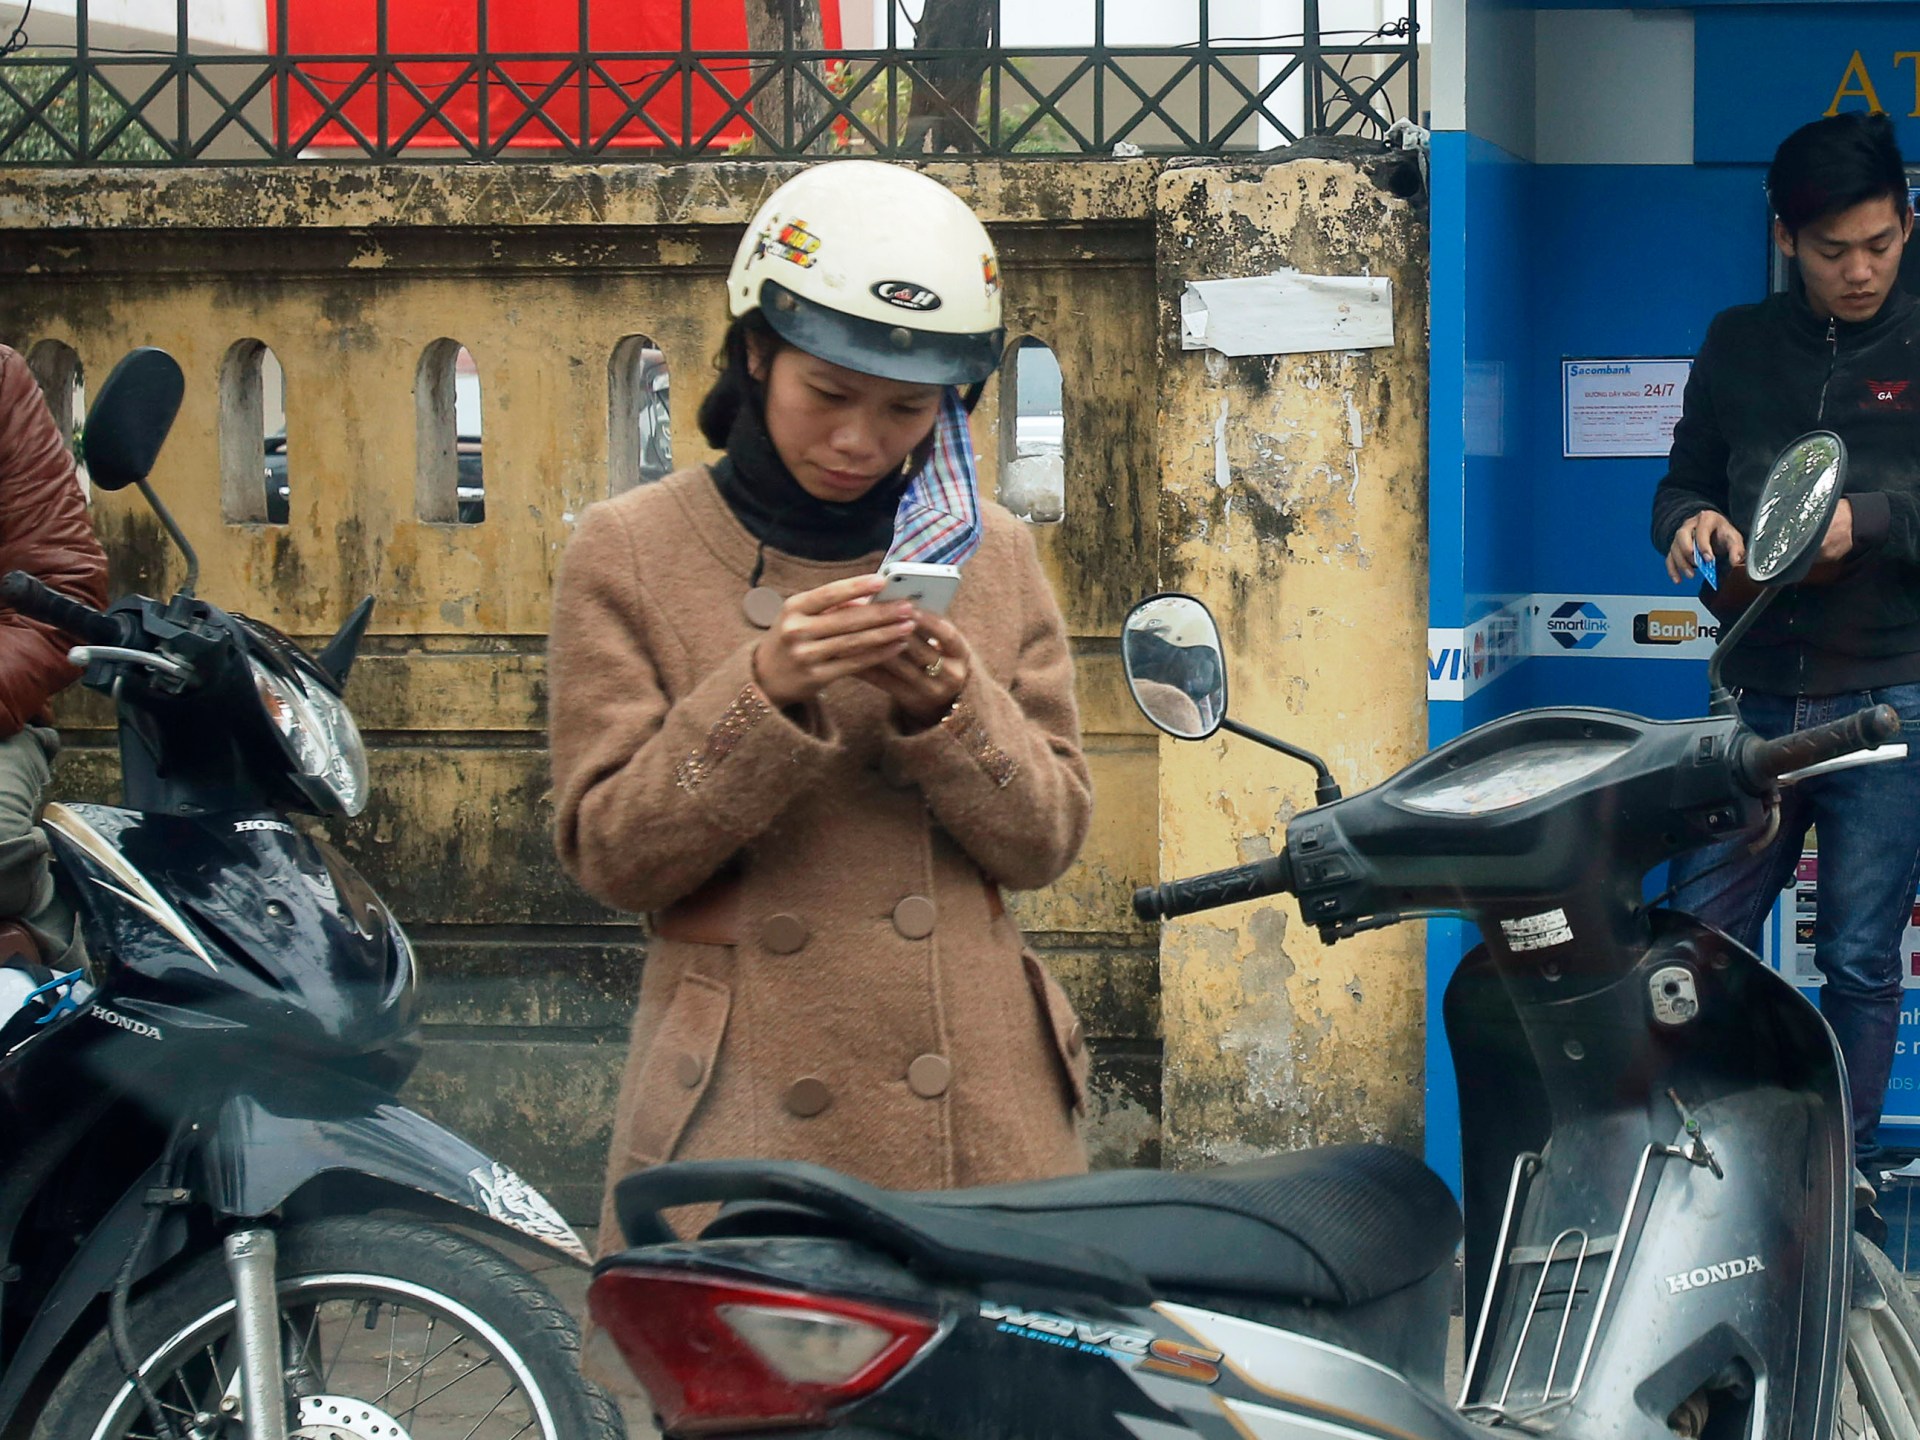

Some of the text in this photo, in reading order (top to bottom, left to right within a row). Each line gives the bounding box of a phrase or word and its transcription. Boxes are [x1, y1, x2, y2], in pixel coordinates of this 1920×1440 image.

[1570, 365, 1632, 377] Sacombank
[1644, 384, 1675, 397] 24/7
[1877, 391, 1893, 400] GA
[1547, 619, 1608, 631] smartlink
[1650, 621, 1718, 639] Bankne
[91, 1005, 163, 1040] HONDA
[1665, 1255, 1765, 1294] HONDA
